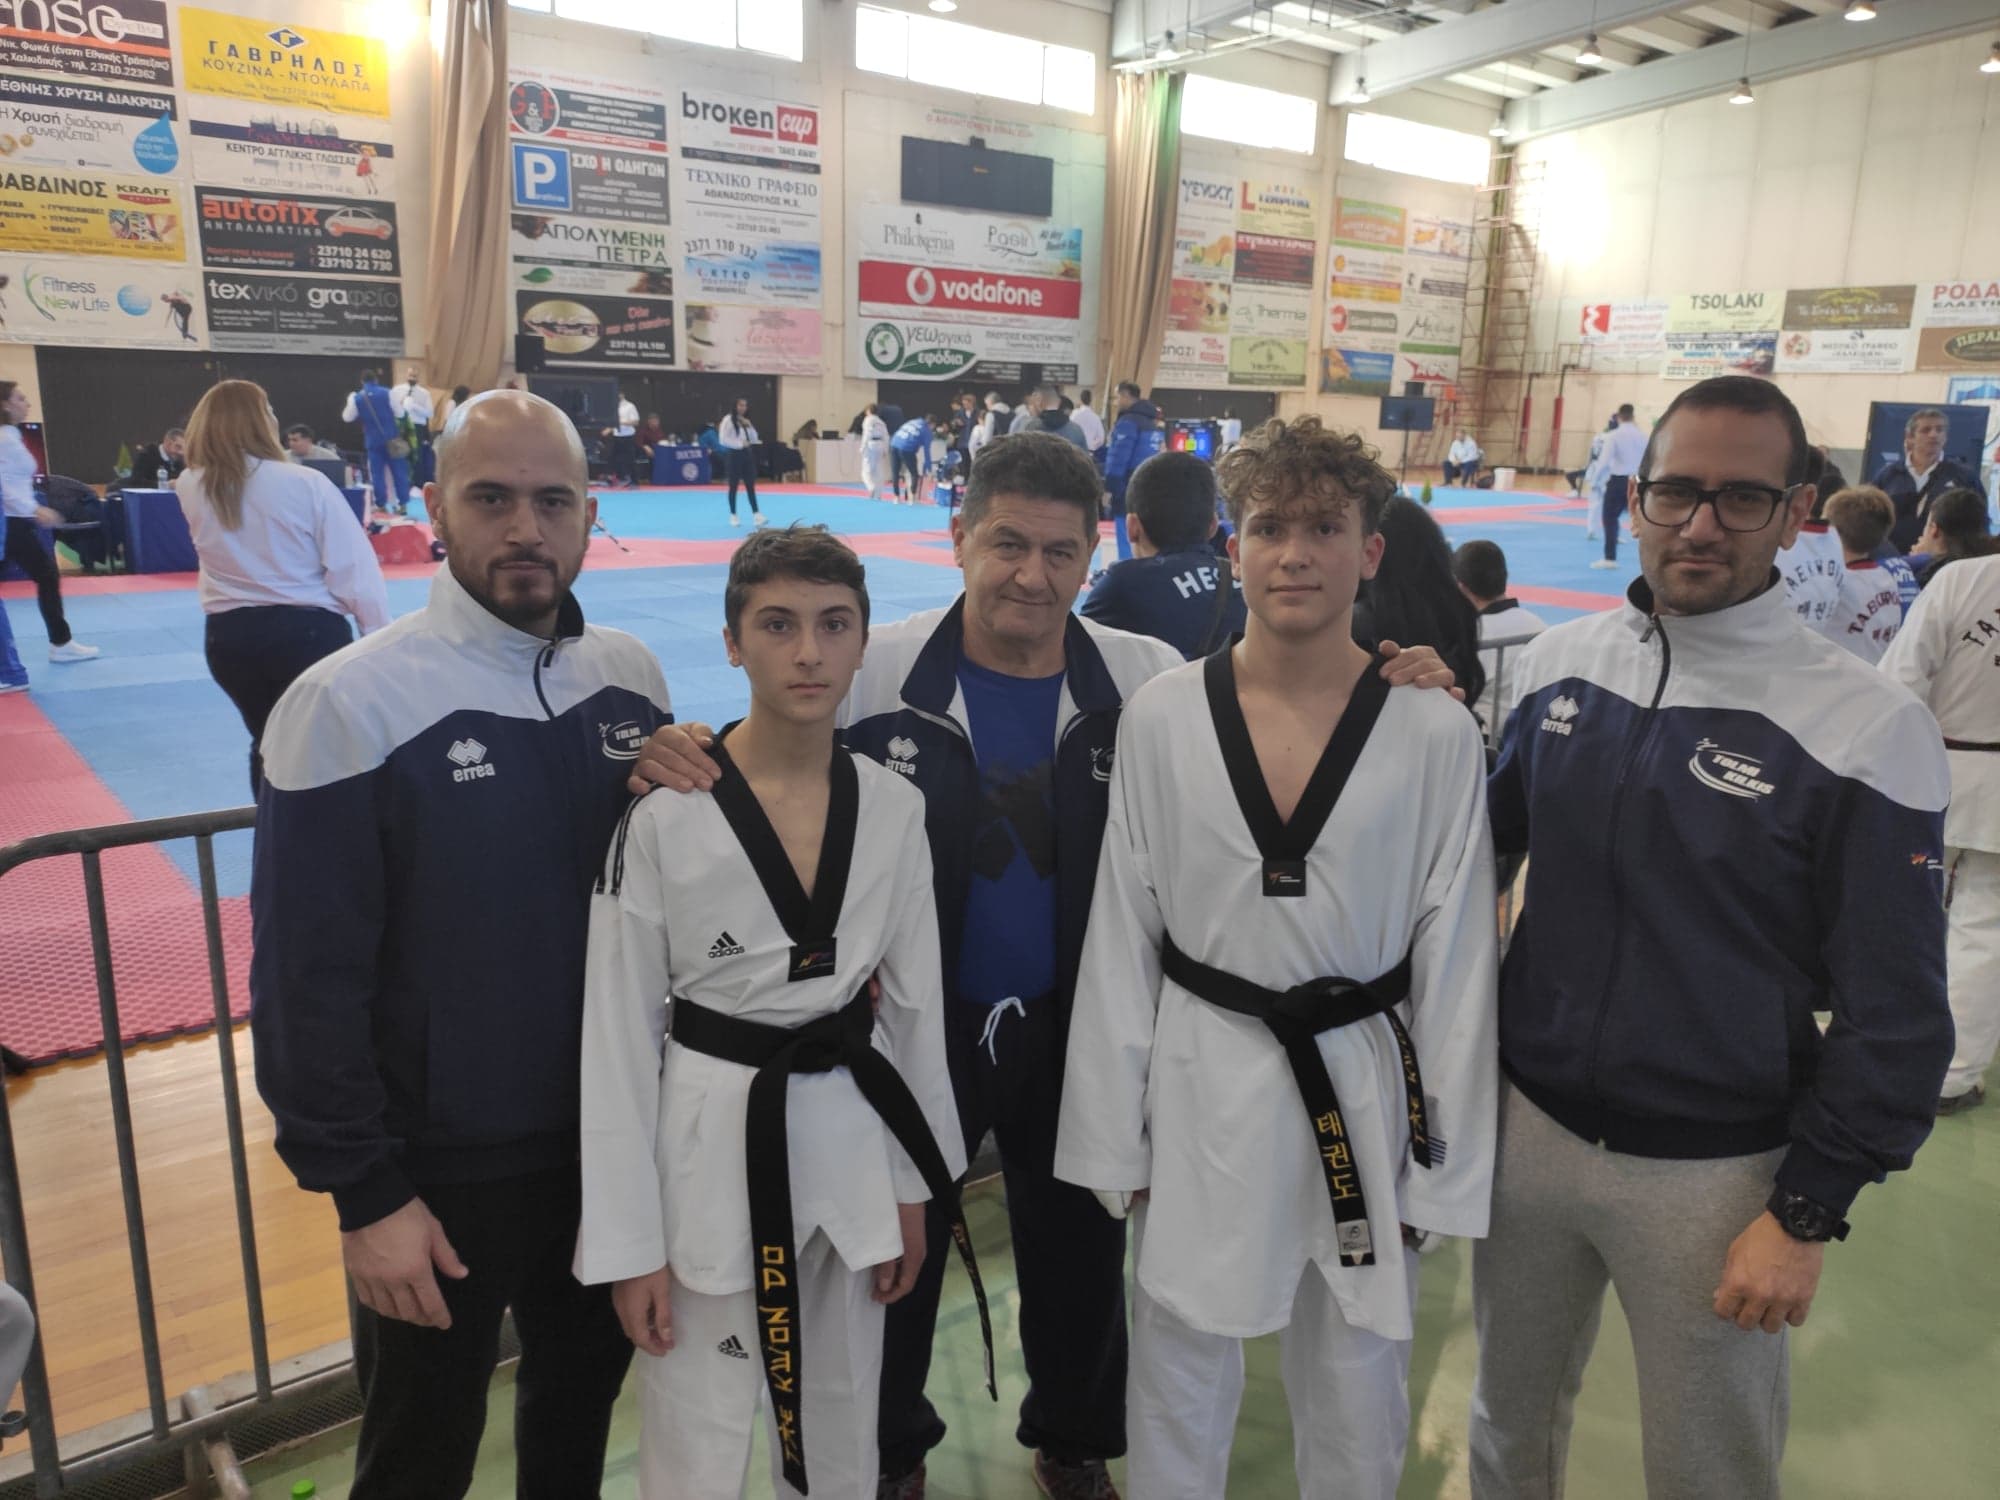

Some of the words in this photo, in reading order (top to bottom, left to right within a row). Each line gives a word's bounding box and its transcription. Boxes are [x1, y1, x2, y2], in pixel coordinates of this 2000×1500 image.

[208, 40, 364, 78] ΓΑΒΡΗΛΟΣ
[203, 58, 274, 78] ΚΟΥΖΙΝΑ
[289, 71, 370, 92] ΝΤΟΥΛΑΠΑ
[56, 87, 104, 102] ΧΡΥΣΗ
[106, 94, 171, 111] ΔΙΑΚΡΙΣΗ
[12, 108, 61, 125] Χρυσή
[682, 91, 774, 130] broken
[780, 113, 813, 141] cup
[226, 142, 265, 156] ΚΕΝΤΡΟ
[116, 184, 169, 197] KRAFT
[686, 168, 751, 189] ΤΕΧΝΙΚΟ
[758, 177, 818, 197] ΓΡΑΦΕΙΟ
[202, 197, 319, 226] autofix
[597, 246, 667, 265] ΠΕΤΡΑ
[42, 276, 97, 294] Fitness
[942, 278, 1043, 307] vodafone
[44, 295, 80, 311] New
[83, 296, 110, 312] Life
[1690, 292, 1764, 310] TSOLAKI
[906, 327, 972, 345] γεωργικά
[918, 348, 964, 368] εφόδια
[1540, 718, 1573, 737] errea
[453, 762, 496, 783] errea
[1712, 754, 1761, 778] TOLMI
[1723, 770, 1776, 796] KILKIS
[708, 945, 745, 959] adidas
[1315, 1110, 1361, 1201] 태권도
[762, 1245, 788, 1292] DO
[758, 1306, 794, 1392] KWON
